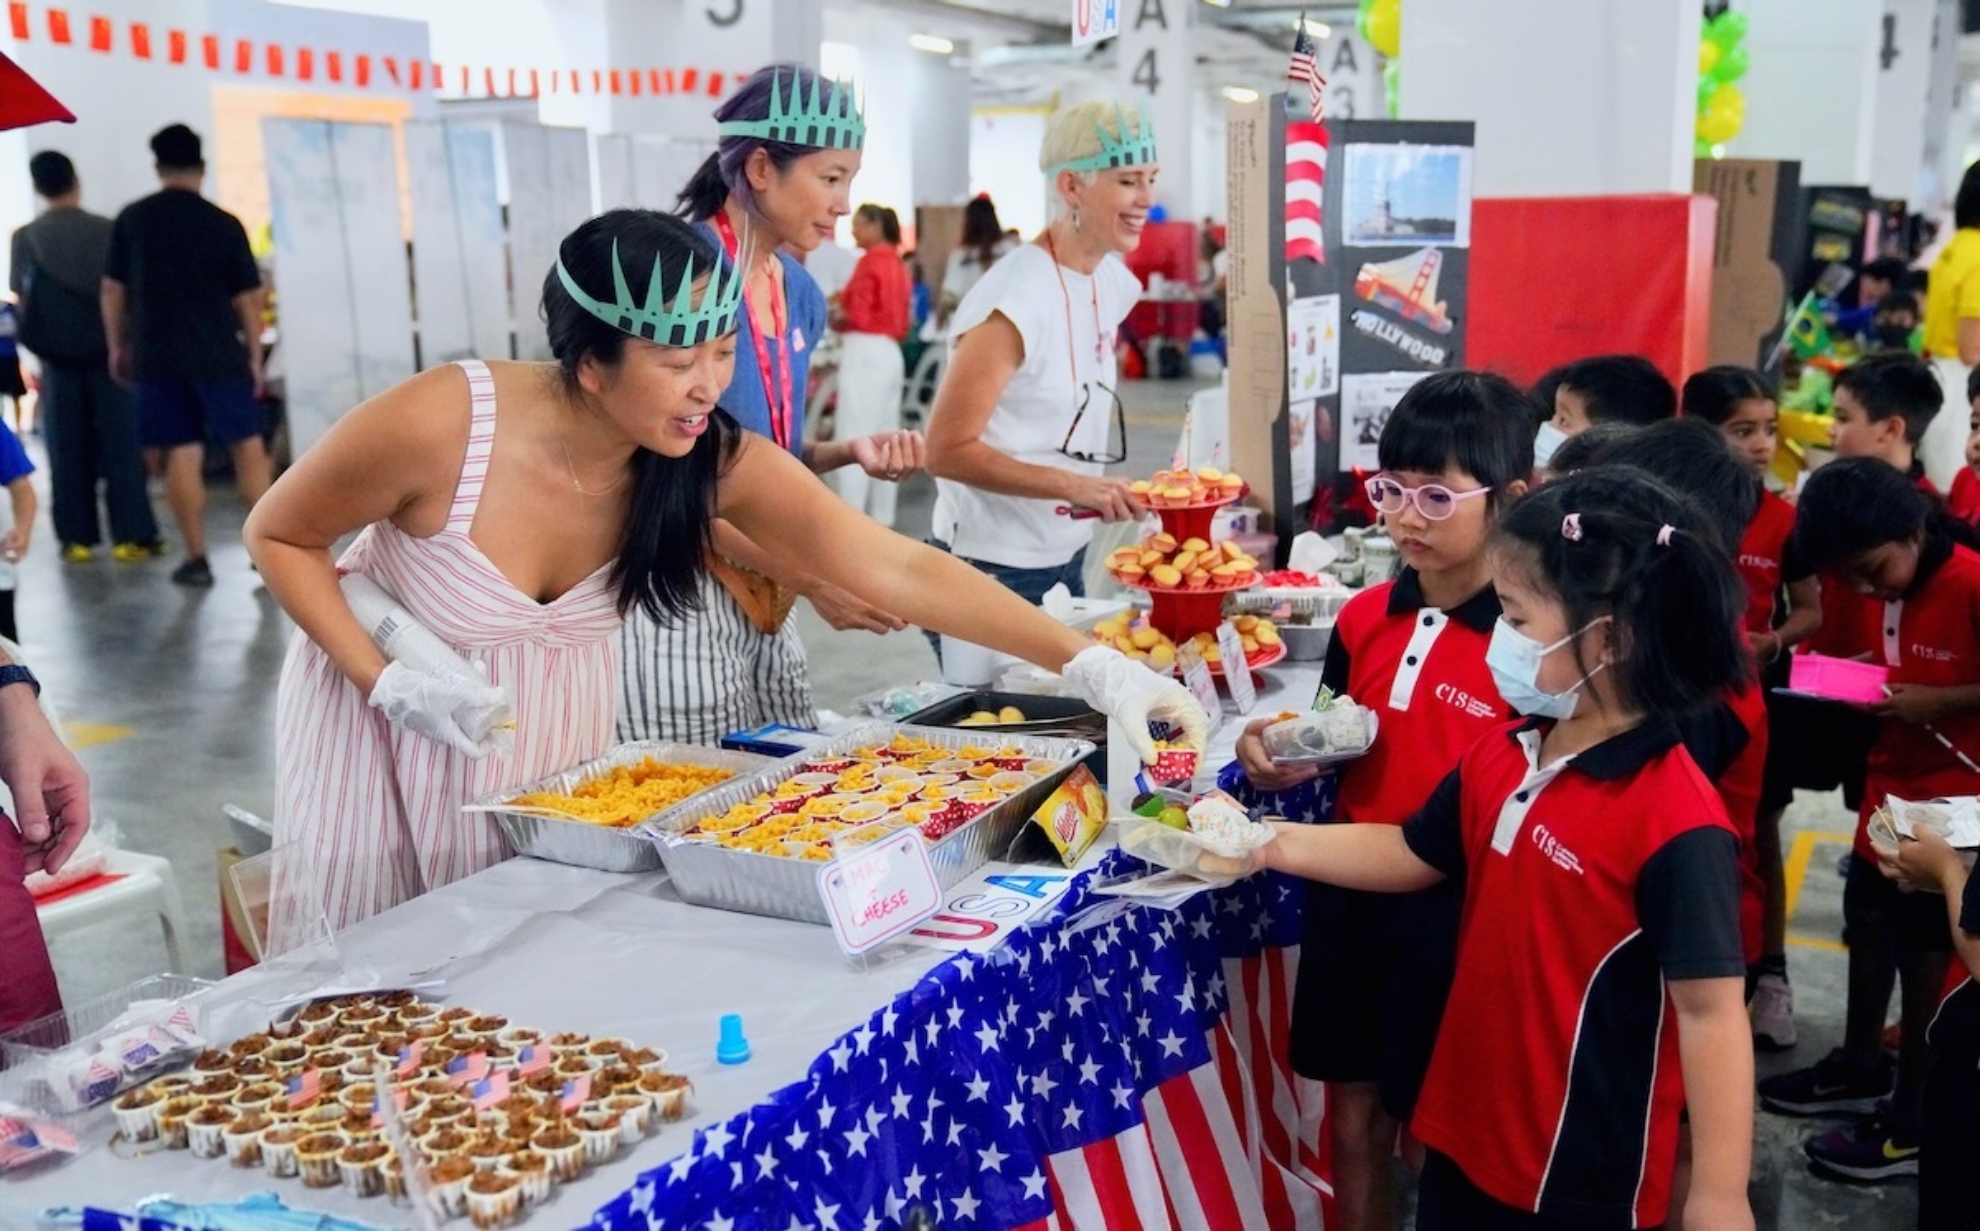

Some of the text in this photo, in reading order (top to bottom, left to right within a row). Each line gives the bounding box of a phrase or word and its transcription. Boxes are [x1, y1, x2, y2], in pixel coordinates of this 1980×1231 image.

[1131, 48, 1161, 95] 4
[1331, 37, 1358, 75] A
[1434, 682, 1469, 709] CIS
[1532, 824, 1557, 857] CIS
[851, 888, 909, 927] CHEESE
[909, 875, 1069, 942] USA
